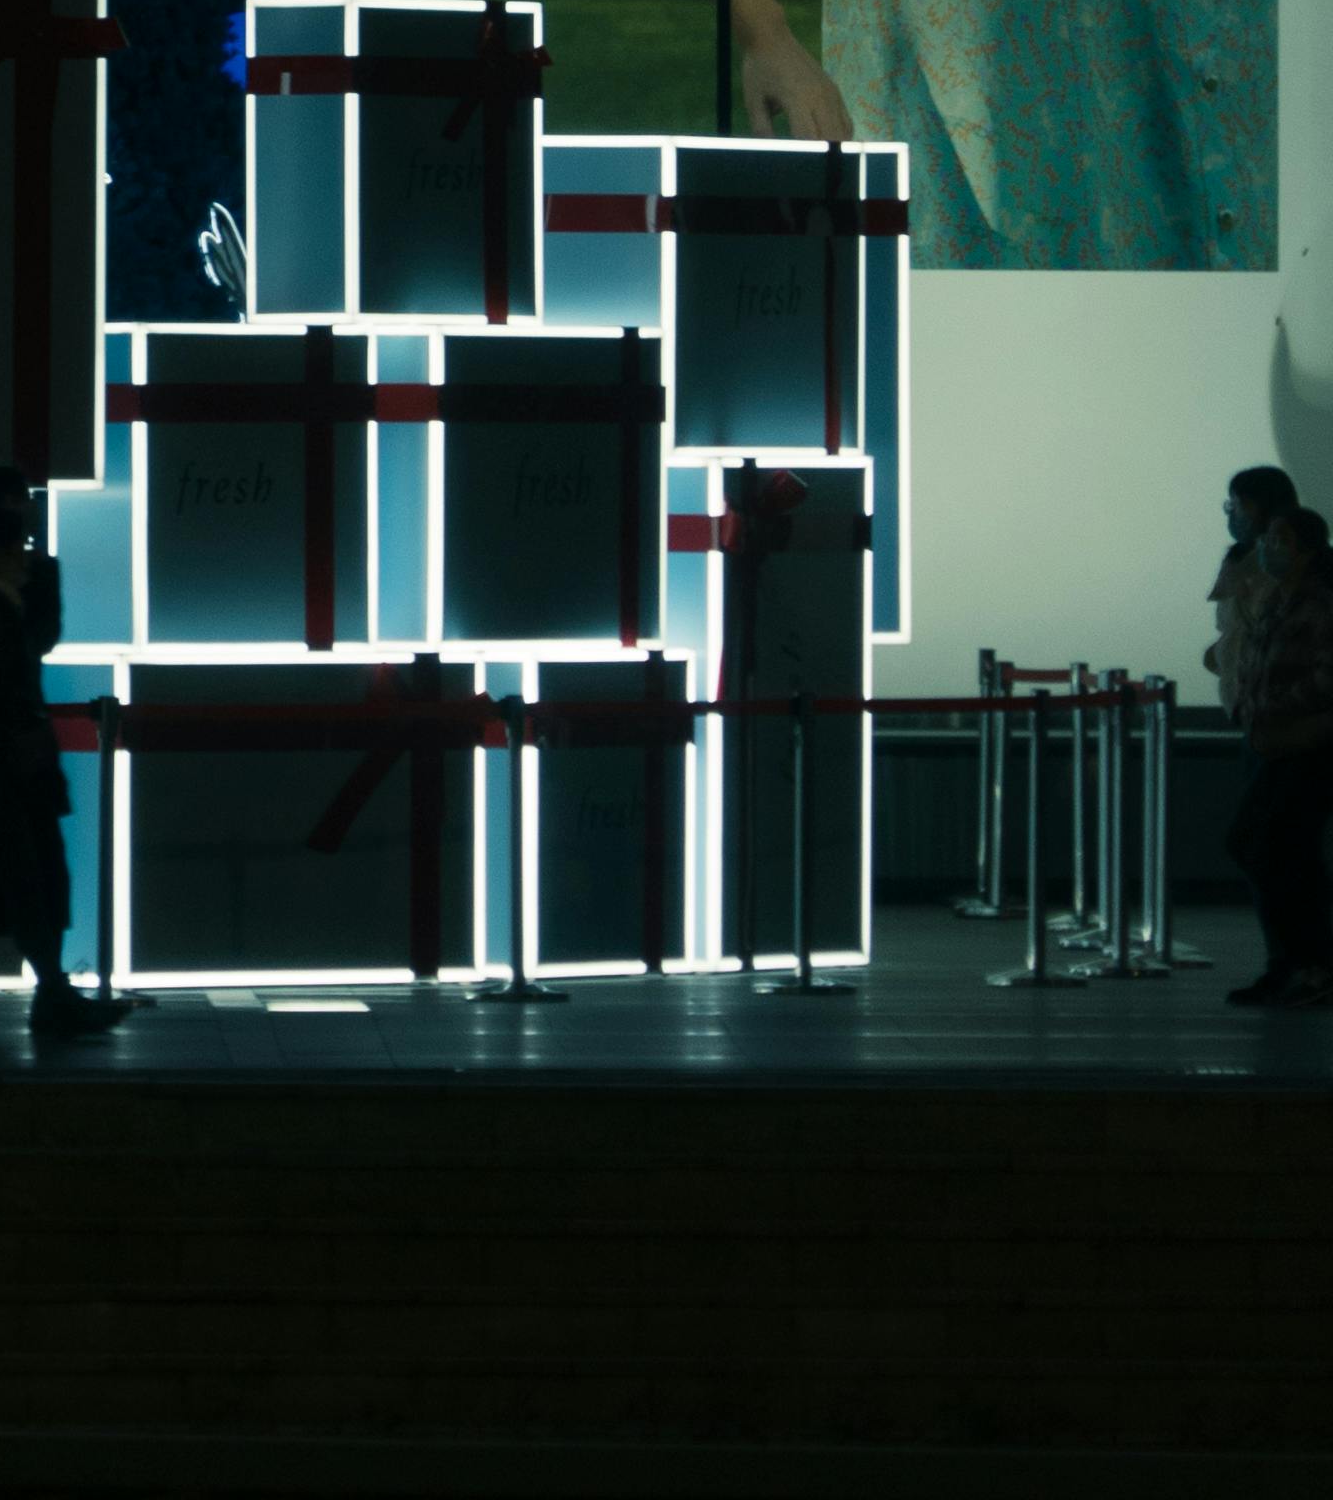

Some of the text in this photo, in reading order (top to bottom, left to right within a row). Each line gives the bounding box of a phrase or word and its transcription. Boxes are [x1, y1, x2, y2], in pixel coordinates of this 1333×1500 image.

[734, 262, 803, 330] fresh
[175, 460, 276, 517] fresh
[513, 451, 592, 520] fresh
